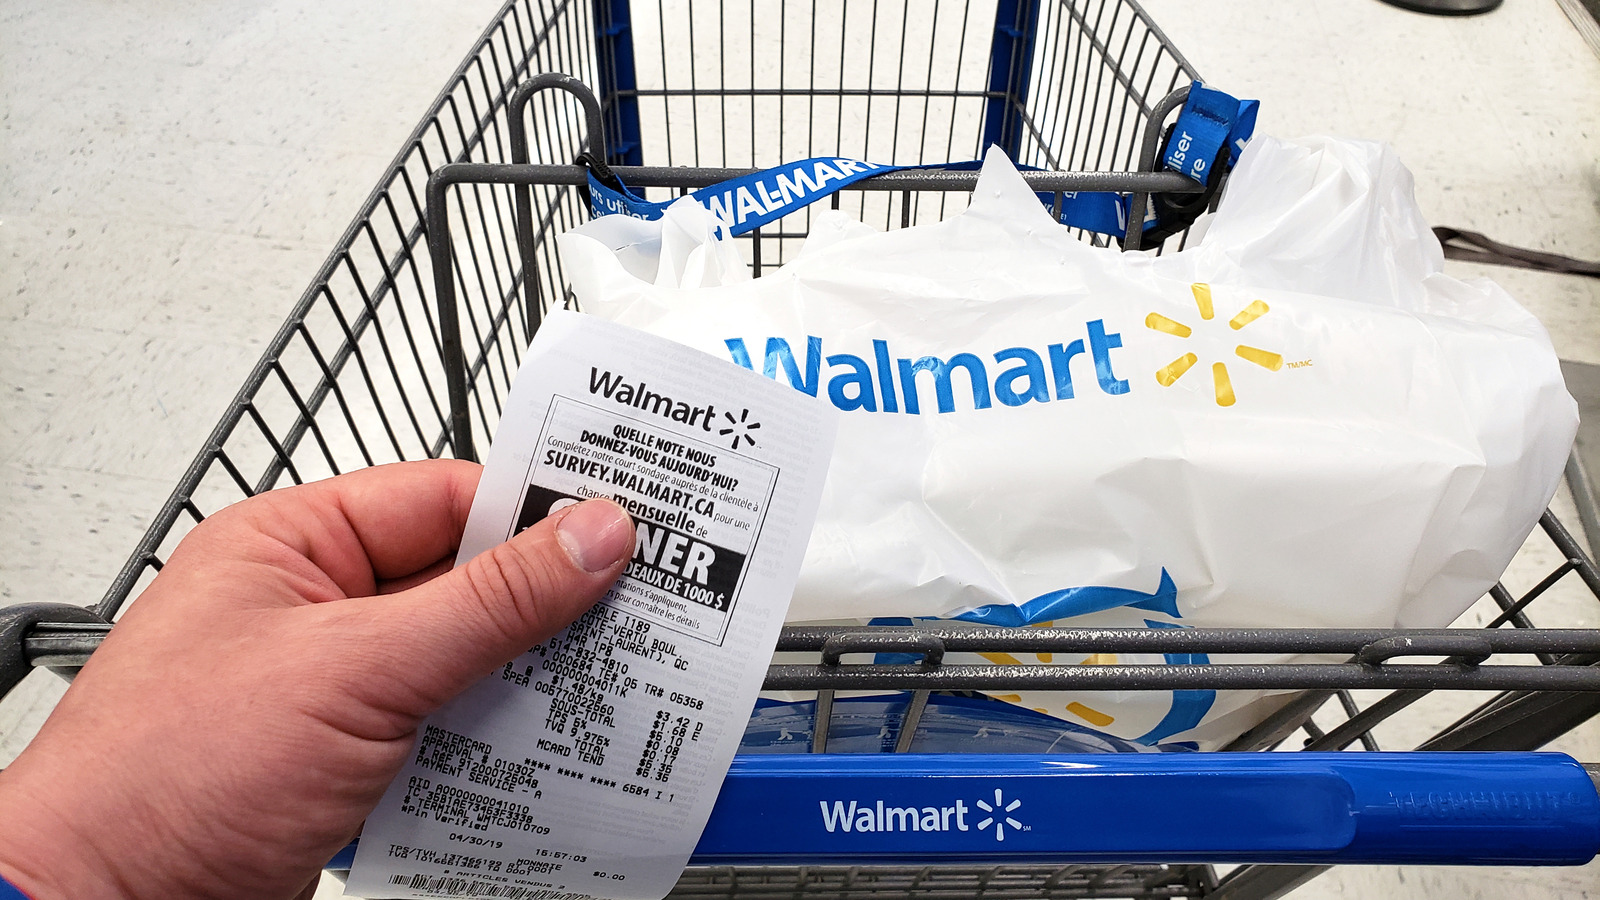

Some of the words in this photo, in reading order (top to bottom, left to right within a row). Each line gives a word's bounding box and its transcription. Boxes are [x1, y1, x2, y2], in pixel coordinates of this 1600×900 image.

[724, 318, 1131, 415] Walmart
[589, 366, 716, 432] Walmart
[580, 429, 659, 465] DONNEZ-VOUS
[658, 455, 739, 492] AUJOURD'HUI?
[613, 424, 655, 447] QUELLE
[655, 437, 685, 458] NOTE
[685, 447, 717, 468] NOUS
[543, 449, 715, 518] SURVEY.WALMART.CA
[713, 512, 734, 525] pour
[734, 520, 750, 531] une
[547, 435, 591, 457] Complétez
[591, 450, 614, 463] notre
[614, 457, 636, 470] court
[637, 464, 671, 483] sondage
[670, 476, 698, 492] auprès
[698, 484, 710, 496] de
[710, 487, 718, 499] la
[719, 491, 753, 510] clientèle
[752, 501, 759, 512] à
[612, 492, 696, 533] mensuelle
[695, 525, 708, 539] de
[615, 579, 644, 596] ntations
[645, 589, 688, 613] s'appliquent,
[663, 575, 683, 594] DE
[683, 582, 715, 606] 1000
[714, 592, 725, 610] $
[590, 604, 620, 623] SALE
[624, 615, 651, 634] 1189
[613, 592, 632, 604] pour
[631, 598, 665, 617] connaître
[664, 608, 675, 621] les
[675, 613, 700, 630] détails
[566, 630, 588, 648] H4R
[593, 640, 614, 657] 1P8
[570, 620, 666, 664] SAINT-LAURENT),
[673, 658, 689, 671] QC
[580, 612, 648, 645] COTE-VERTU
[651, 638, 682, 658] BOUL.
[552, 650, 593, 674] 000684
[599, 667, 619, 683] TE#
[623, 676, 639, 690] 05
[644, 682, 665, 698] TR#
[669, 691, 704, 711] 05358
[502, 669, 530, 688] SPEA
[652, 719, 687, 738] $1.68
[691, 731, 701, 742] E
[551, 674, 604, 702] $1.48/kg
[655, 710, 691, 729] $3.42
[695, 721, 704, 732] D
[424, 724, 493, 755] MASTERCARD
[548, 707, 568, 724] TPS
[645, 739, 680, 757] $0.08
[550, 697, 616, 728] SOUS-TOTAL
[648, 729, 683, 747] $5.10
[421, 735, 474, 761] APPROVAL
[431, 749, 454, 763] REF
[536, 738, 572, 757] MCARD
[577, 750, 605, 767] TEND
[544, 718, 565, 735] TVQ
[569, 727, 611, 748] 9.975%
[642, 748, 677, 765] $0.17
[574, 738, 606, 757] TOTAL
[407, 786, 421, 797] TC
[408, 775, 431, 790] AID
[415, 755, 464, 778] PAYMENT
[468, 771, 517, 793] SERVICE
[533, 790, 543, 800] A
[418, 798, 470, 820] TERMINAL
[434, 811, 489, 832] Verified
[819, 799, 969, 833] Walmart
[389, 844, 437, 858] TPS/TVH
[448, 832, 503, 849] 04/30/19
[456, 871, 509, 883] ARTICLES
[514, 879, 553, 888] VENDUS
[516, 858, 563, 871] MONNAIE
